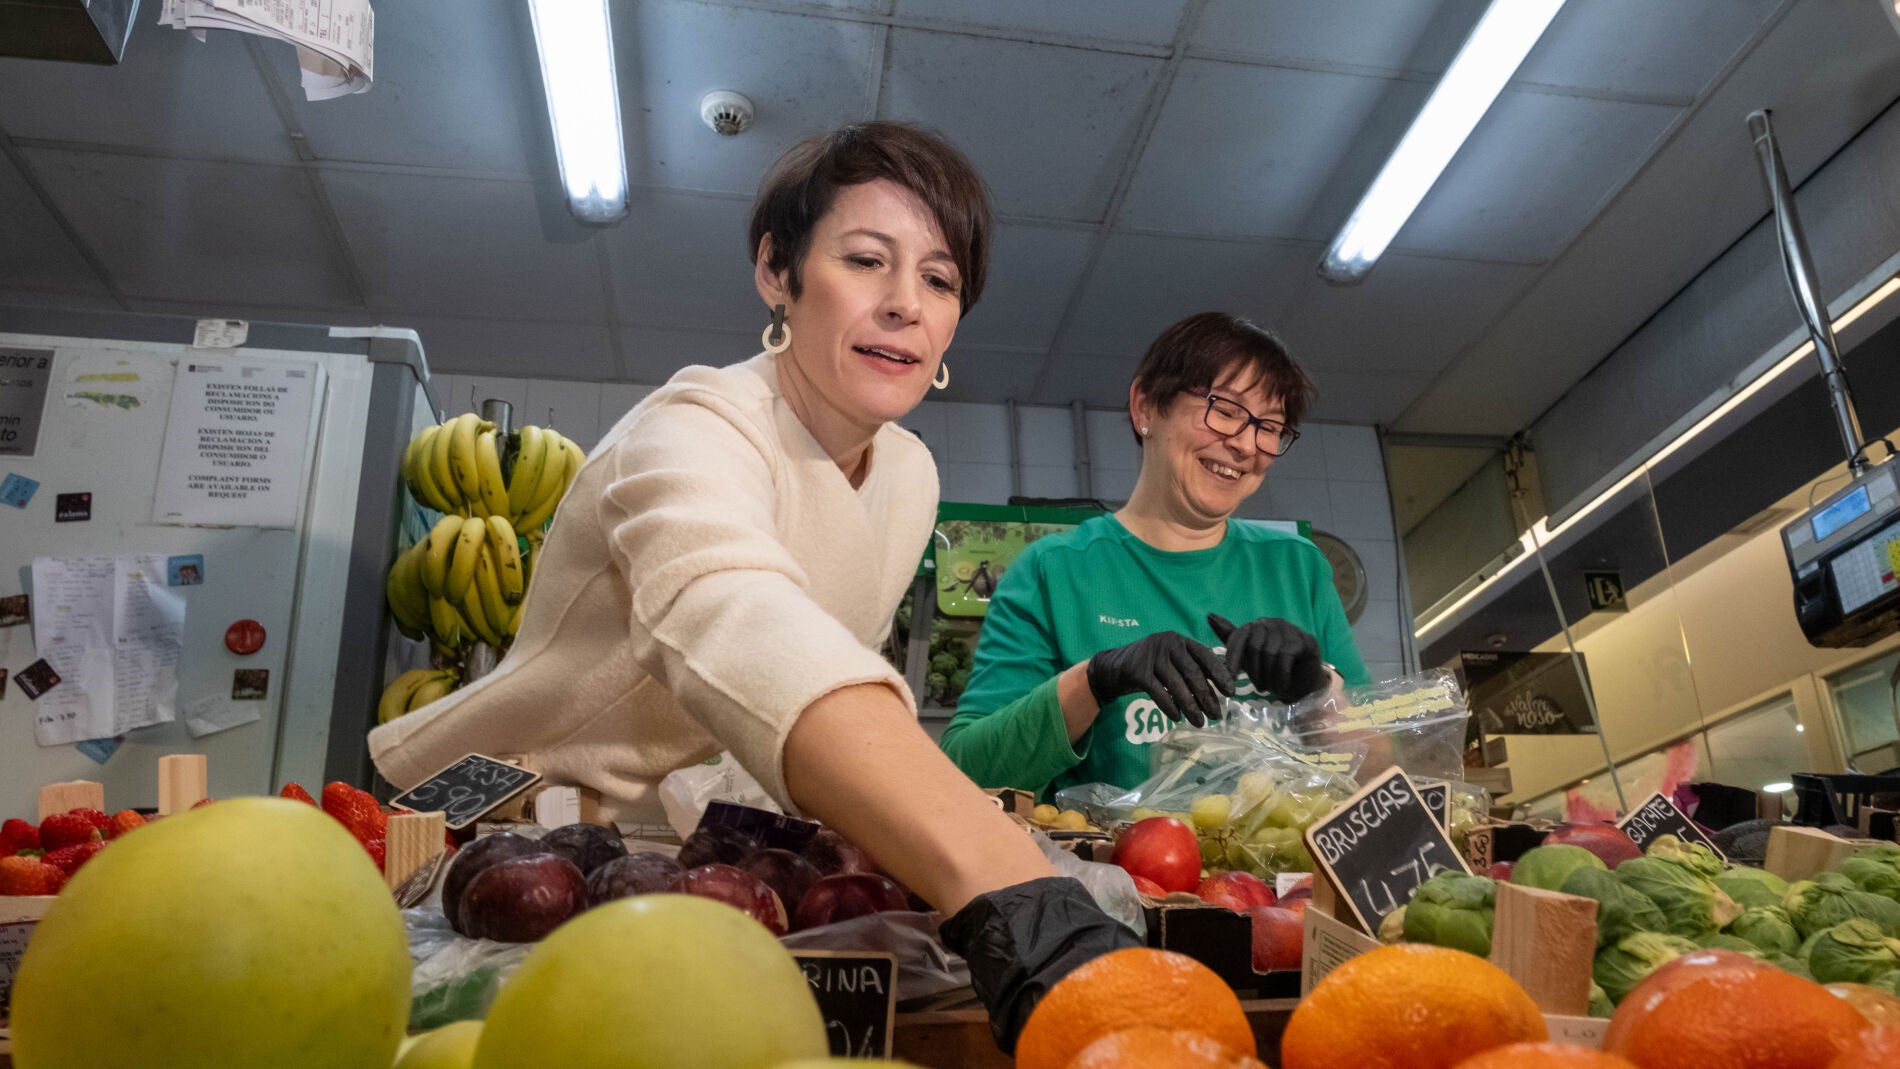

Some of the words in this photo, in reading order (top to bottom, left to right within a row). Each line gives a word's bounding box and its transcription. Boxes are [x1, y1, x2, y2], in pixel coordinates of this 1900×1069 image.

[37, 358, 48, 369] a
[206, 383, 242, 391] EXISTEN
[204, 406, 261, 414] CONSUMIDOR
[197, 428, 233, 436] EXISTEN
[200, 452, 258, 460] CONSUMIDOR
[188, 475, 239, 483] COMPLAINT
[451, 757, 524, 791] FRESA
[1316, 780, 1411, 865] BRUSELAS
[1626, 798, 1675, 844] GUACATE
[802, 964, 884, 994] RINA
